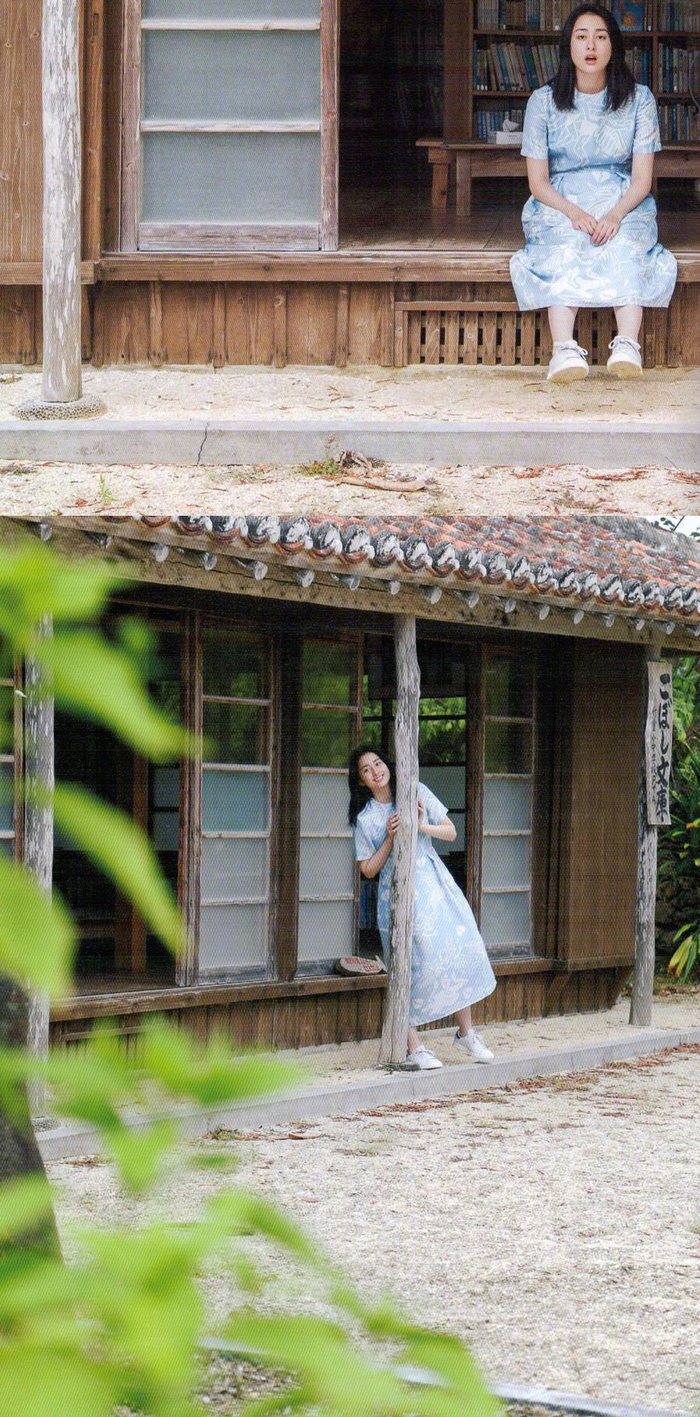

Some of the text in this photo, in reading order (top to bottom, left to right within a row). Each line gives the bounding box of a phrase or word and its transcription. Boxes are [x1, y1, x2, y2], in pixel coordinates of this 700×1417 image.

[656, 673, 672, 822] こぼし文庫
